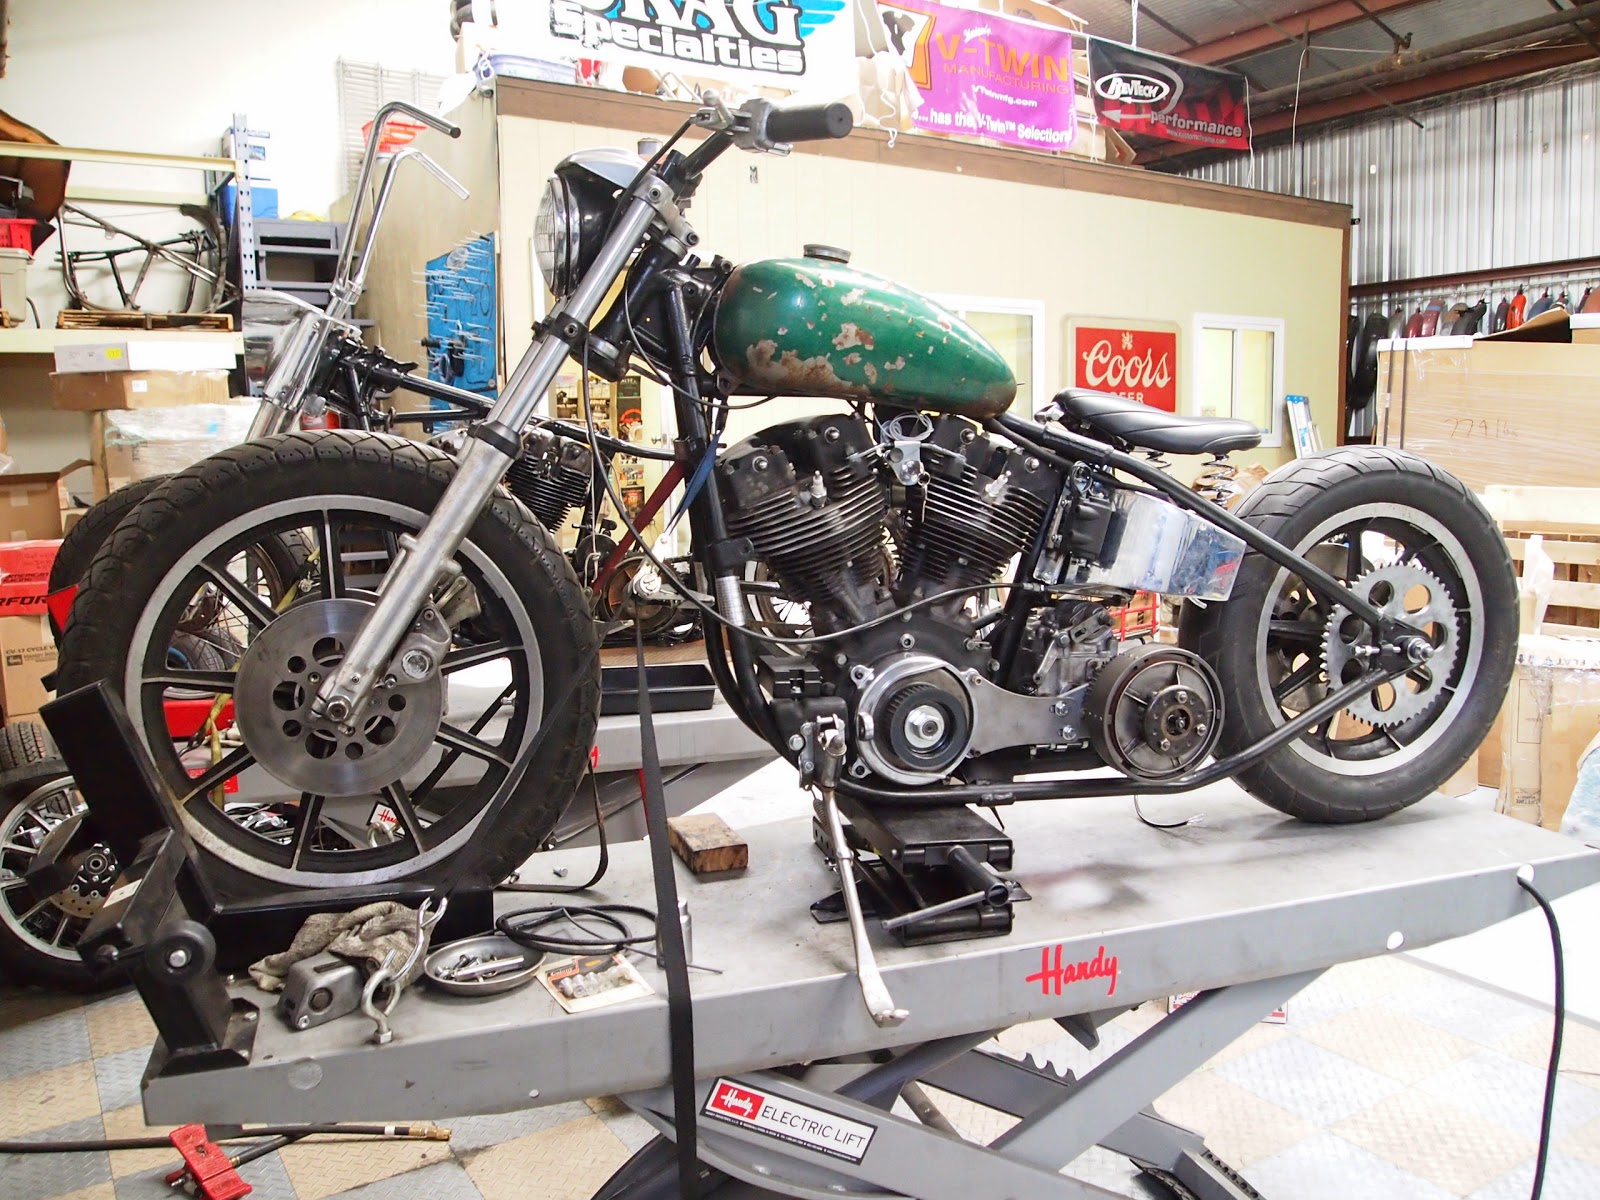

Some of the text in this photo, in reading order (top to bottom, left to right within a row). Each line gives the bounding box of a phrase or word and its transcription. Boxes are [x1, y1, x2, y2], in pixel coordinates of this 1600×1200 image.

[551, 2, 804, 74] Specialties
[935, 32, 1069, 82] V-TWIN
[943, 63, 1070, 94] MANUFACTURING
[930, 107, 952, 126] has
[1150, 110, 1242, 137] performance
[1083, 339, 1171, 388] Coors
[1110, 391, 1144, 404] ER
[1025, 943, 1118, 996] Handy
[720, 1088, 754, 1117] Handy
[761, 1105, 833, 1138] ELECTRIC
[834, 1128, 866, 1149] LIFT
